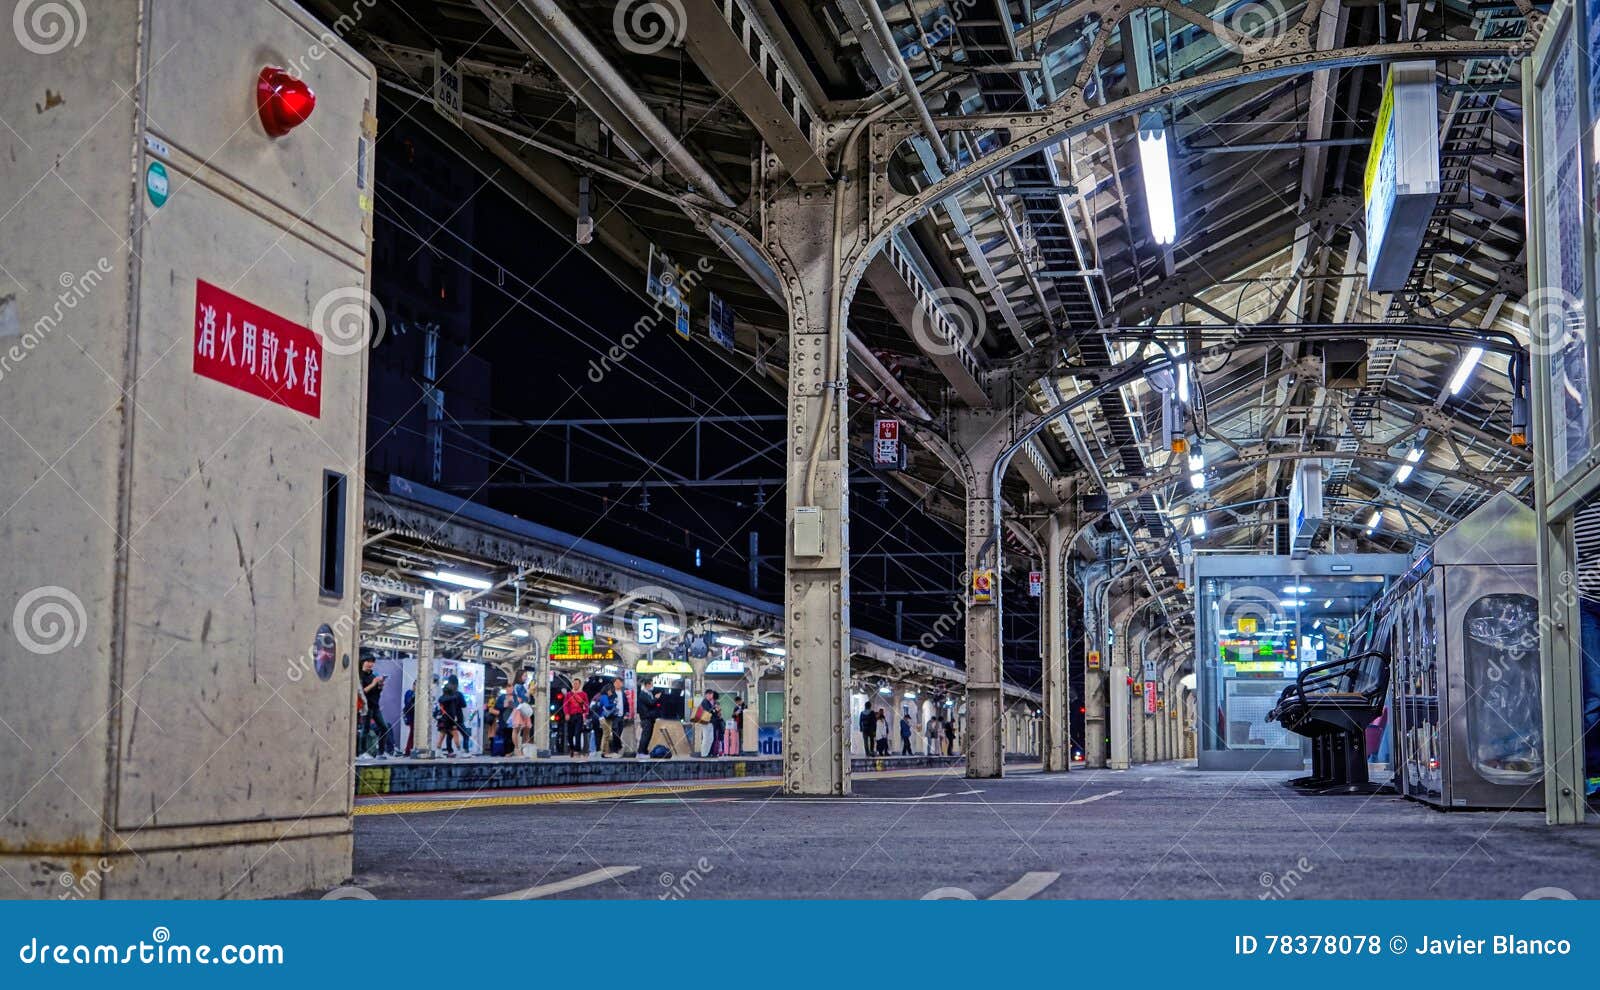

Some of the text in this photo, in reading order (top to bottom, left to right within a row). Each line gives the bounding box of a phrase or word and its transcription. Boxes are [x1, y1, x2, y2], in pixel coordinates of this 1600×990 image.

[198, 303, 319, 397] 消火用散水栓
[643, 623, 653, 639] 5
